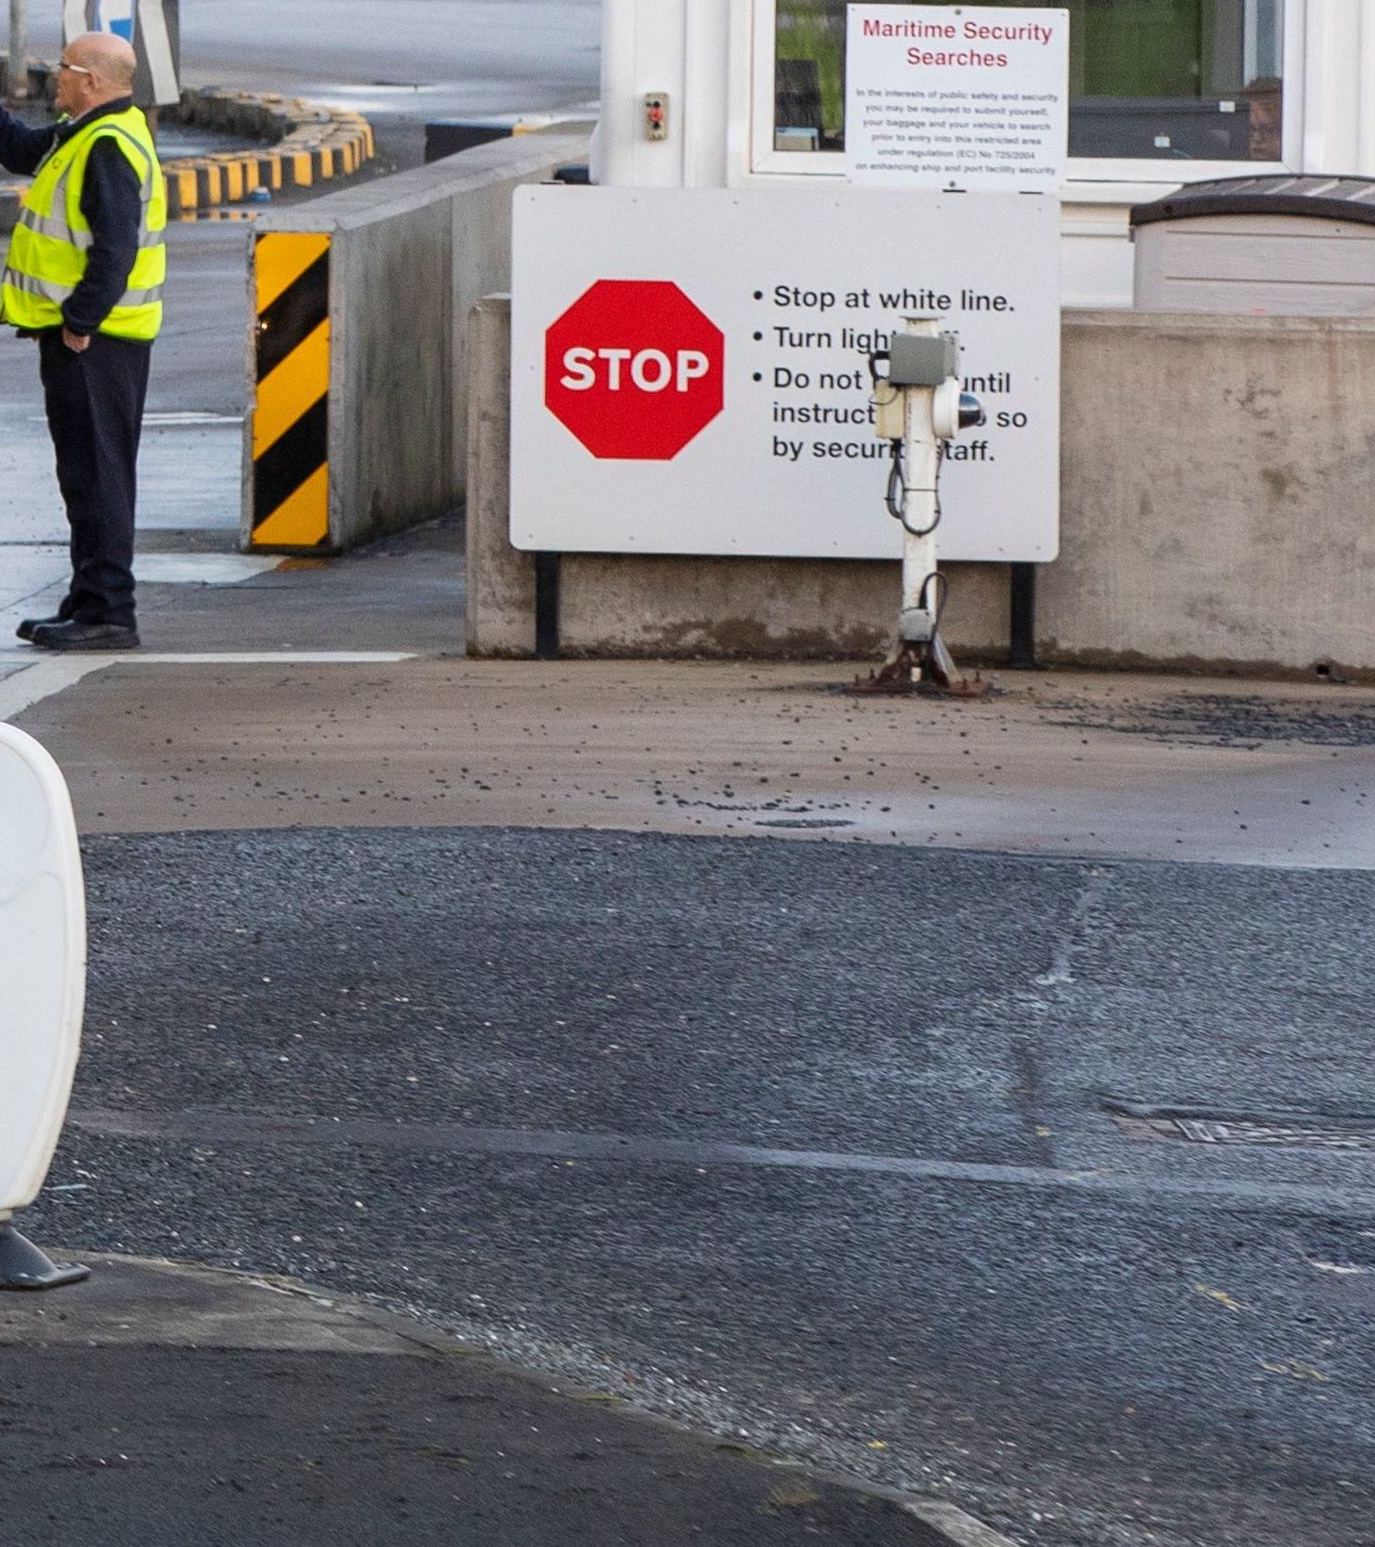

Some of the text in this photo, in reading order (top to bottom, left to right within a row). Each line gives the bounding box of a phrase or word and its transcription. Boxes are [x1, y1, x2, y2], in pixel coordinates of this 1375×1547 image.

[862, 19, 1053, 45] Maritime Security
[907, 47, 1008, 68] Searches
[773, 284, 1015, 312] Stop at white line.
[773, 326, 898, 355] Turn ligh
[559, 346, 711, 393] STOP
[773, 367, 810, 389] Do
[819, 369, 863, 390] not
[772, 401, 876, 425] instruct
[996, 411, 1028, 428] so
[772, 435, 995, 461] by securit taff.
